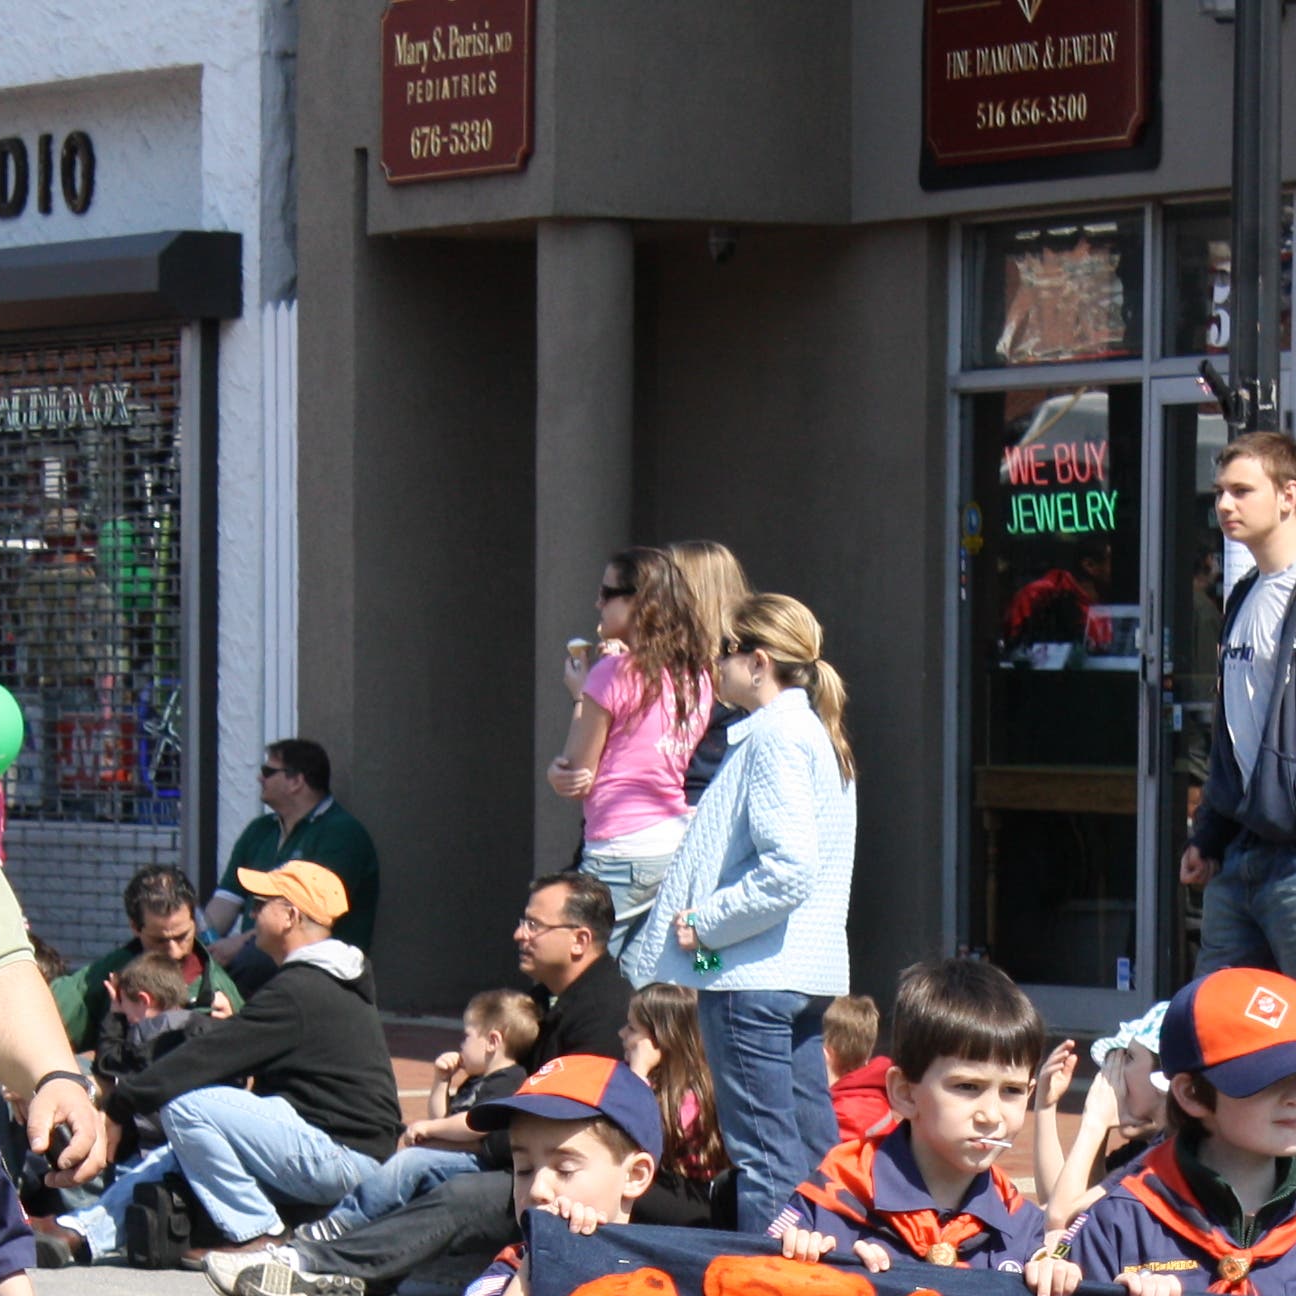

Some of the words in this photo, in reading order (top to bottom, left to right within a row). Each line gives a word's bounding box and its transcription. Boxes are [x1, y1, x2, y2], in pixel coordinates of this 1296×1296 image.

[394, 31, 430, 74] Mary
[432, 26, 446, 62] S.
[448, 20, 494, 60] Parisi,
[946, 50, 972, 80] FINE
[976, 40, 1039, 78] DIAMONDS
[1042, 35, 1055, 71] &
[1057, 30, 1118, 69] JEWELRY
[406, 70, 497, 105] PEDIATRICS
[976, 101, 1005, 130] 516
[1011, 92, 1088, 127] 656-3500
[410, 118, 493, 160] 676-5330
[1005, 444, 1049, 486] WE
[1054, 440, 1109, 485] BUY
[1006, 489, 1119, 534] JEWELRY
